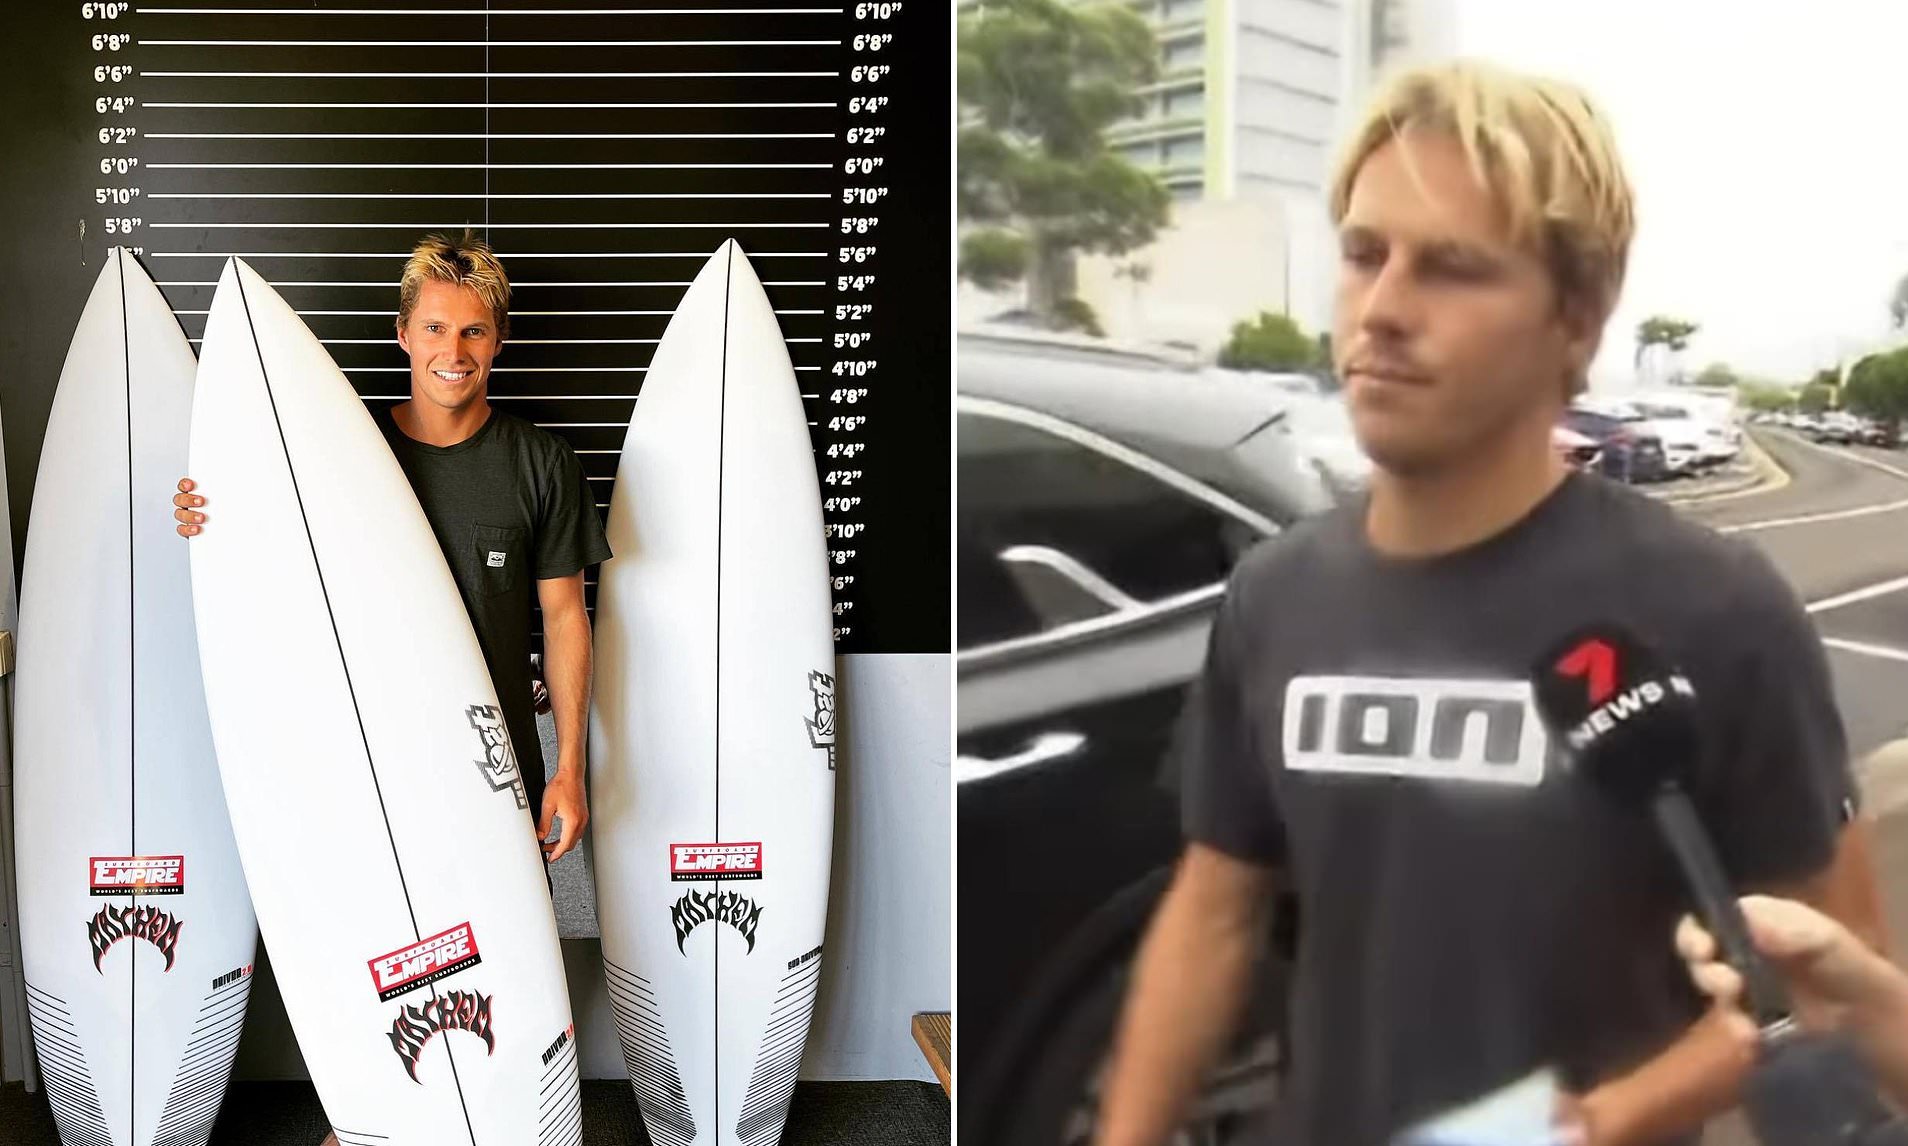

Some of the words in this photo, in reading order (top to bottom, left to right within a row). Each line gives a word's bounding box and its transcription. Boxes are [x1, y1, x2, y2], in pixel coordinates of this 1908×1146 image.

[82, 2, 128, 19] 6’10”
[855, 2, 902, 19] 6’10”
[92, 34, 130, 51] 6’8”
[853, 34, 892, 51] 6’8”
[94, 65, 132, 82] 6’6”
[851, 65, 890, 82] 6’6”
[95, 97, 134, 113] 6’4”
[849, 97, 888, 113] 6’4”
[98, 127, 136, 143] 6’2”
[847, 127, 885, 144] 6’2”
[100, 158, 138, 174] 6’0”
[844, 157, 883, 174] 6’0”
[95, 188, 140, 204] 5’10”
[843, 187, 888, 204] 5’10”
[105, 217, 142, 234] 5’8”
[841, 217, 878, 234] 5’8”
[839, 247, 876, 263] 5’6”
[837, 275, 875, 291] 5’4”
[836, 305, 872, 320] 5’2”
[834, 333, 871, 348] 5’0”
[832, 361, 877, 376] 4’10”
[830, 389, 868, 403] 4’8”
[828, 416, 866, 431] 4’6”
[827, 444, 865, 458] 4’4”
[825, 471, 862, 485] 4’2”
[824, 497, 861, 512] 4’0”
[828, 550, 856, 564] ’8”
[830, 576, 854, 590] ’6”
[1555, 638, 1615, 705] 7
[1569, 681, 1664, 750] NEWS
[674, 850, 758, 870] EMPIRE
[94, 863, 180, 885] EMPIRE
[373, 935, 471, 989] EMPIRE
